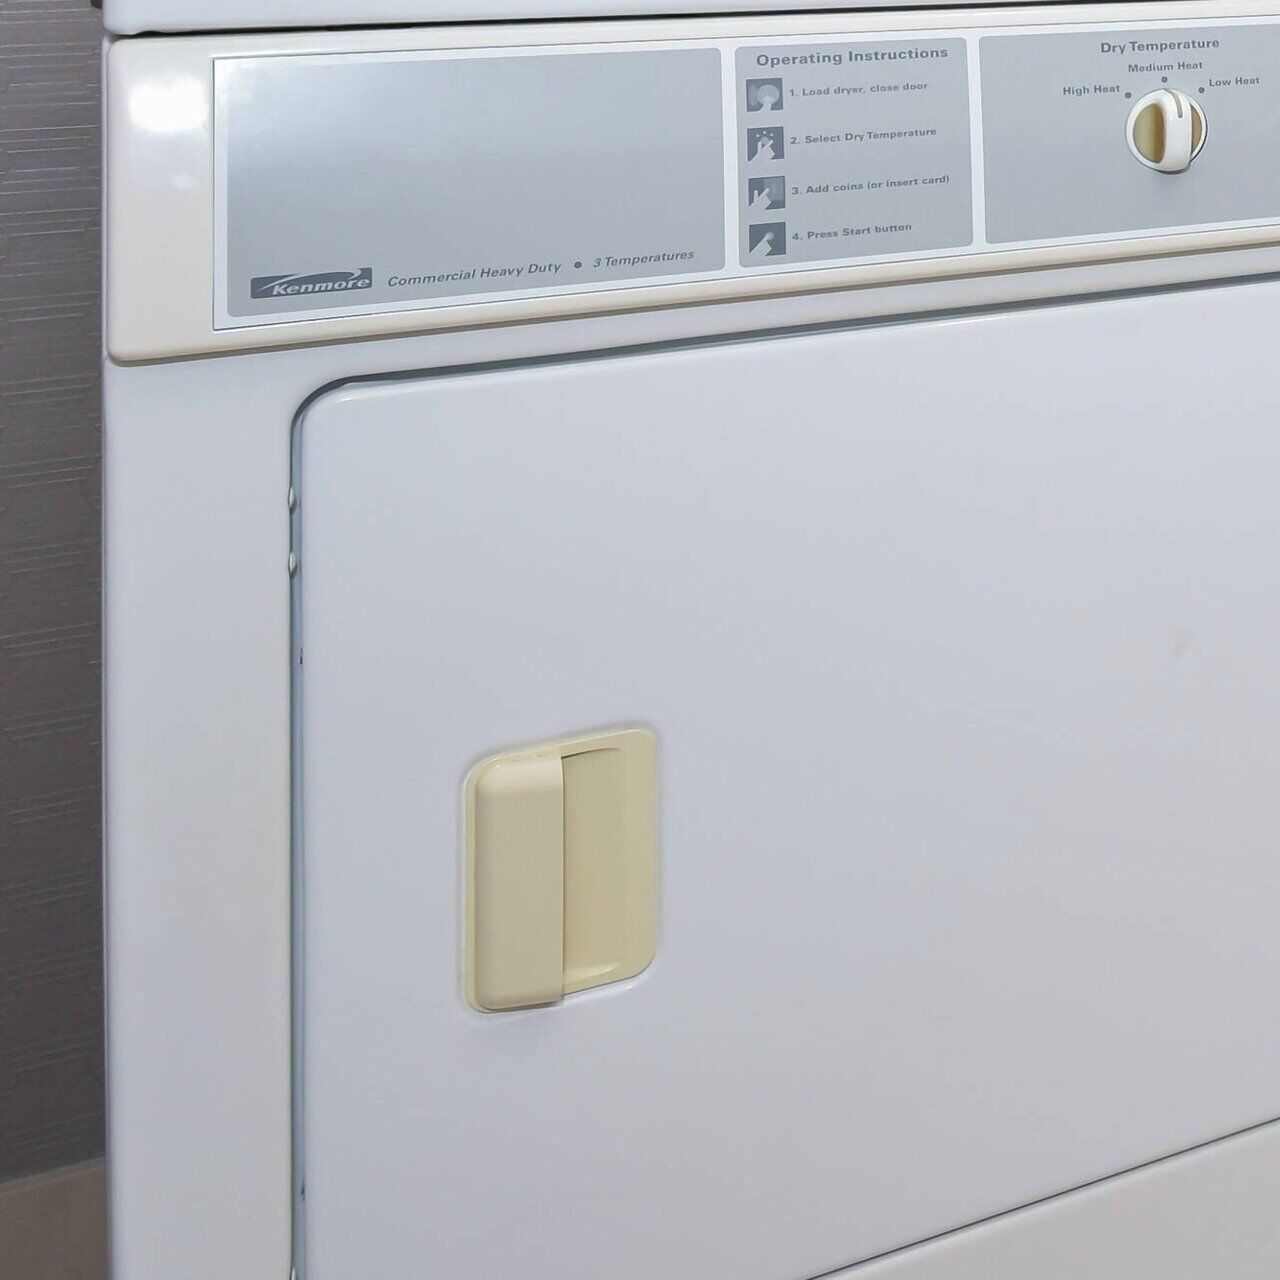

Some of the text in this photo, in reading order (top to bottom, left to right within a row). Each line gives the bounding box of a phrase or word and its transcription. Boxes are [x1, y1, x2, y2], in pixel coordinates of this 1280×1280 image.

[1100, 38, 1220, 55] Dry Temperature
[756, 47, 948, 69] Operating Instructions
[1128, 61, 1203, 73] Medium Heat
[802, 87, 830, 96] Load
[870, 83, 899, 93] close
[903, 82, 928, 91] door
[1209, 76, 1260, 87] Low Heat
[1063, 84, 1120, 96] High Heat
[805, 135, 841, 144] Select
[845, 132, 864, 142] Dry
[866, 128, 937, 140] Temperature
[806, 184, 829, 194] Add
[833, 183, 863, 192] coins
[867, 180, 883, 190] (or
[886, 178, 918, 187] insert
[922, 174, 950, 185] card)
[807, 230, 839, 239] Press
[842, 227, 871, 236] Start
[874, 224, 912, 233] button
[593, 250, 695, 268] 3 Temperatures
[388, 262, 562, 287] Commercial Heavy Duty
[272, 277, 370, 296] Kenmore
